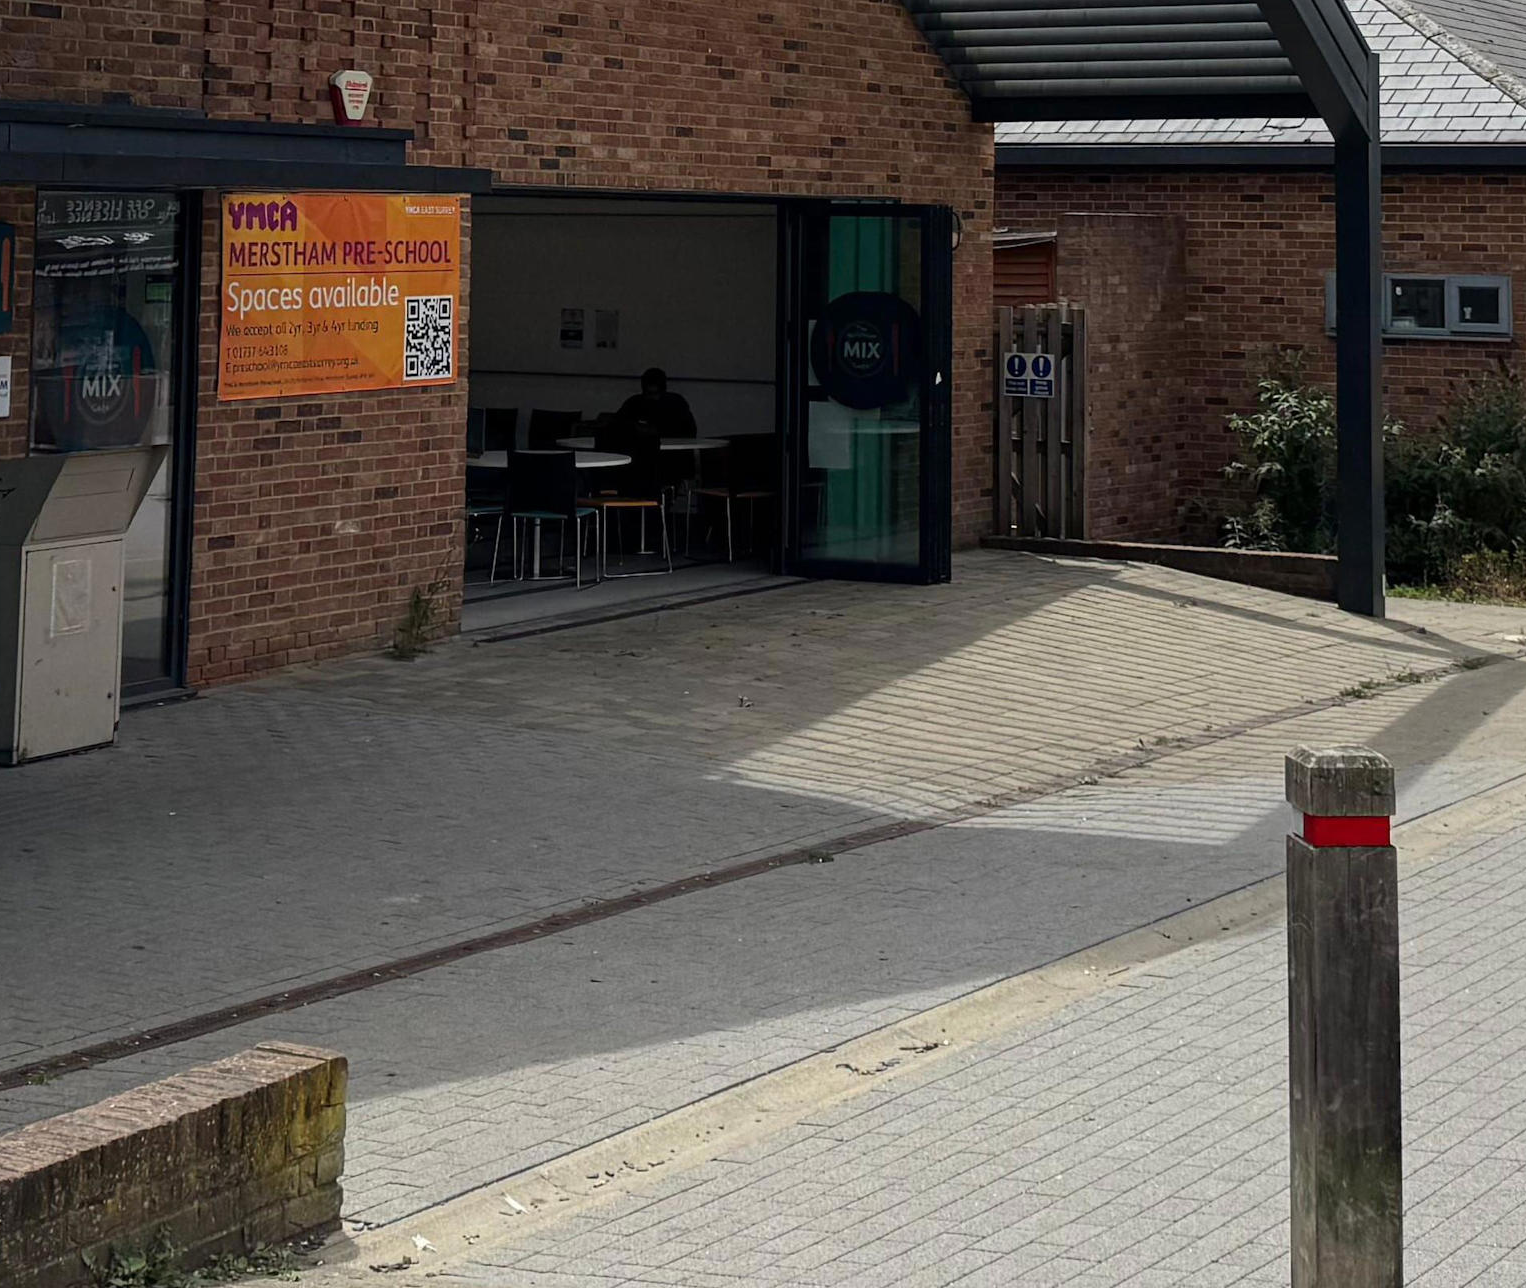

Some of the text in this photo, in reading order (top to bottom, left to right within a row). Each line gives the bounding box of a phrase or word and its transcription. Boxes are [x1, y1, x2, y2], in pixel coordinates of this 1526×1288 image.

[228, 200, 298, 232] YMCA
[229, 240, 451, 267] MERSTHAM PRE-SCHOOL
[227, 277, 399, 320] Spaces available
[226, 326, 240, 337] We
[244, 324, 272, 337] accept
[275, 322, 287, 334] all
[307, 321, 321, 336] 3yr
[322, 320, 329, 332] &
[331, 320, 345, 335] 4yr
[226, 347, 231, 359] T
[232, 346, 256, 359] 01737
[844, 341, 880, 359] MIX
[225, 362, 231, 373] E
[82, 374, 121, 399] MIX
